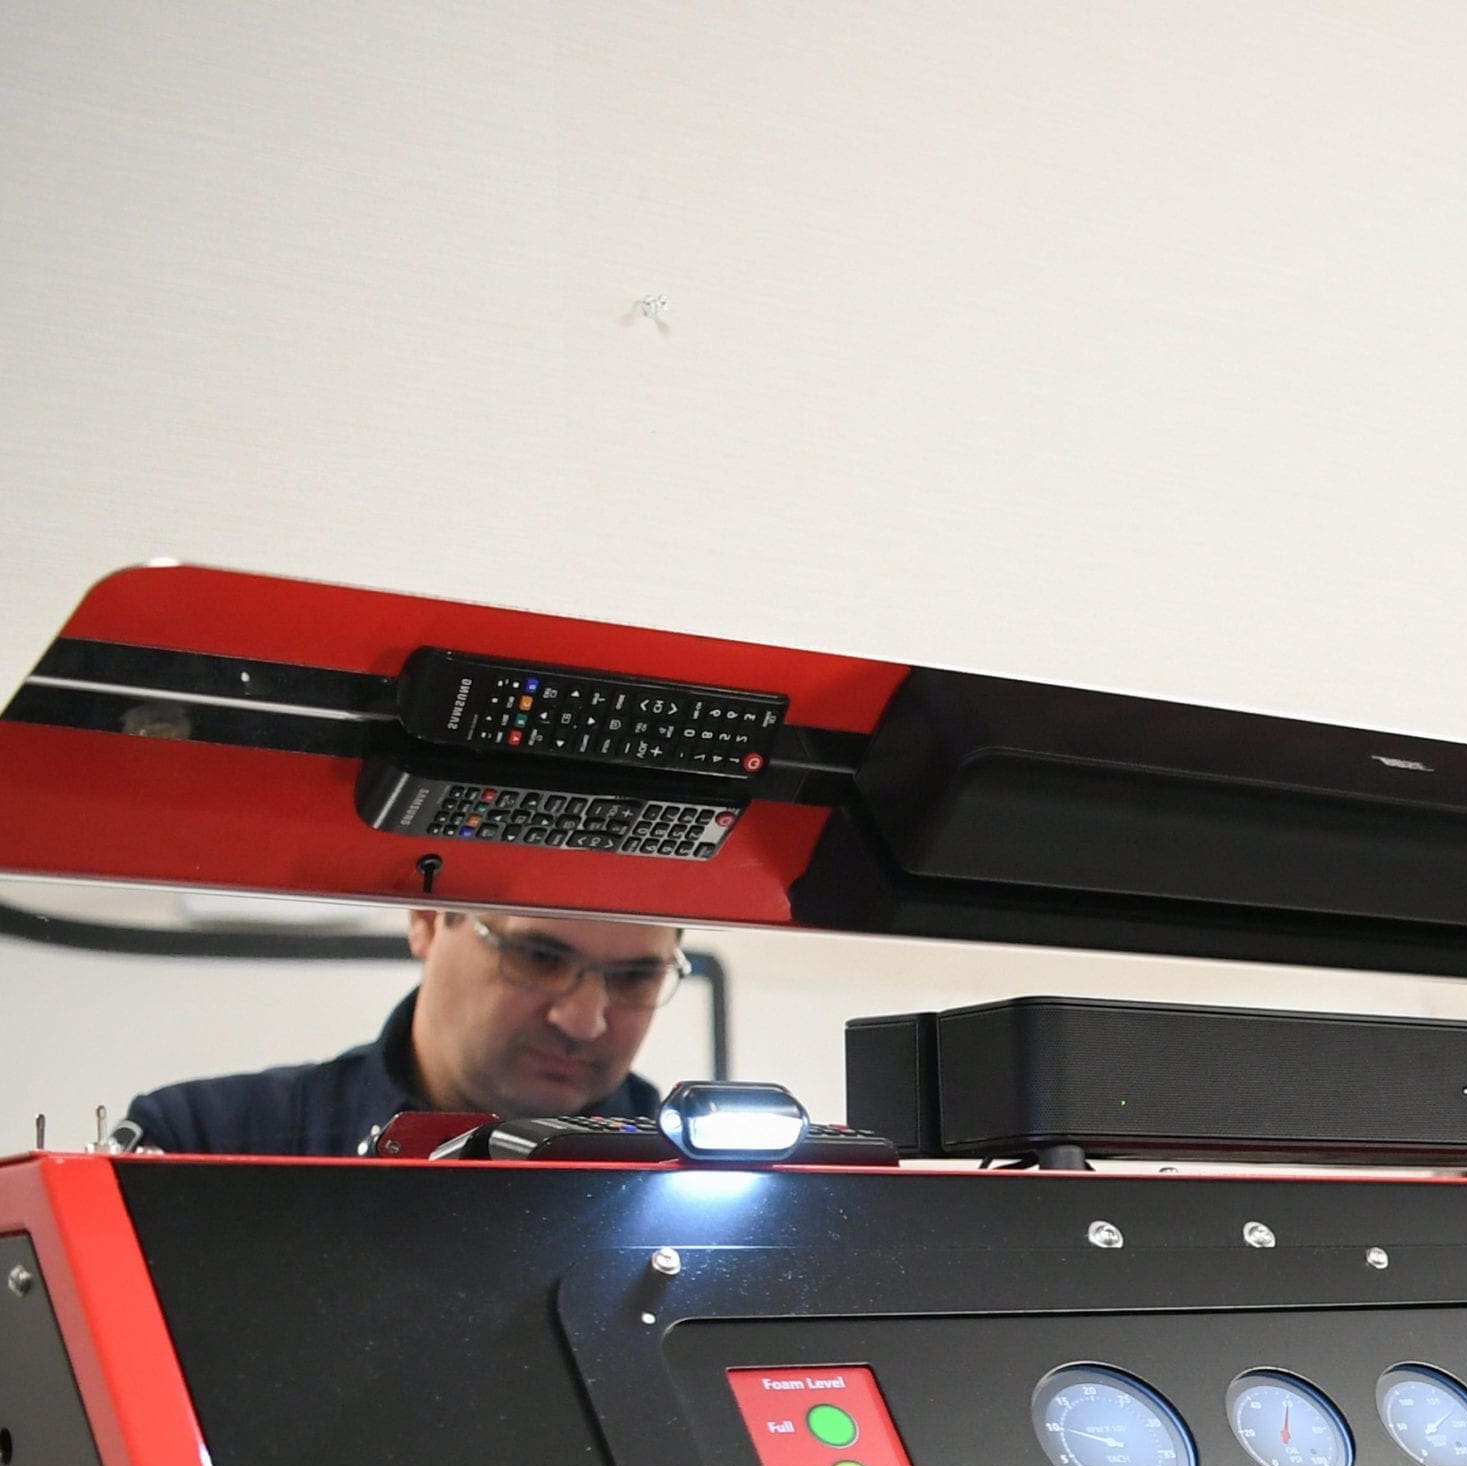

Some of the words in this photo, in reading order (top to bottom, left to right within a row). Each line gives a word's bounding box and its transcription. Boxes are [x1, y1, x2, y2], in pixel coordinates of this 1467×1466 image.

[762, 1378, 805, 1390] Foam
[806, 1376, 846, 1389] Level
[1082, 1387, 1096, 1396] 20
[767, 1421, 795, 1433] Full
[1045, 1423, 1060, 1431] 10
[1060, 1454, 1068, 1464] 5
